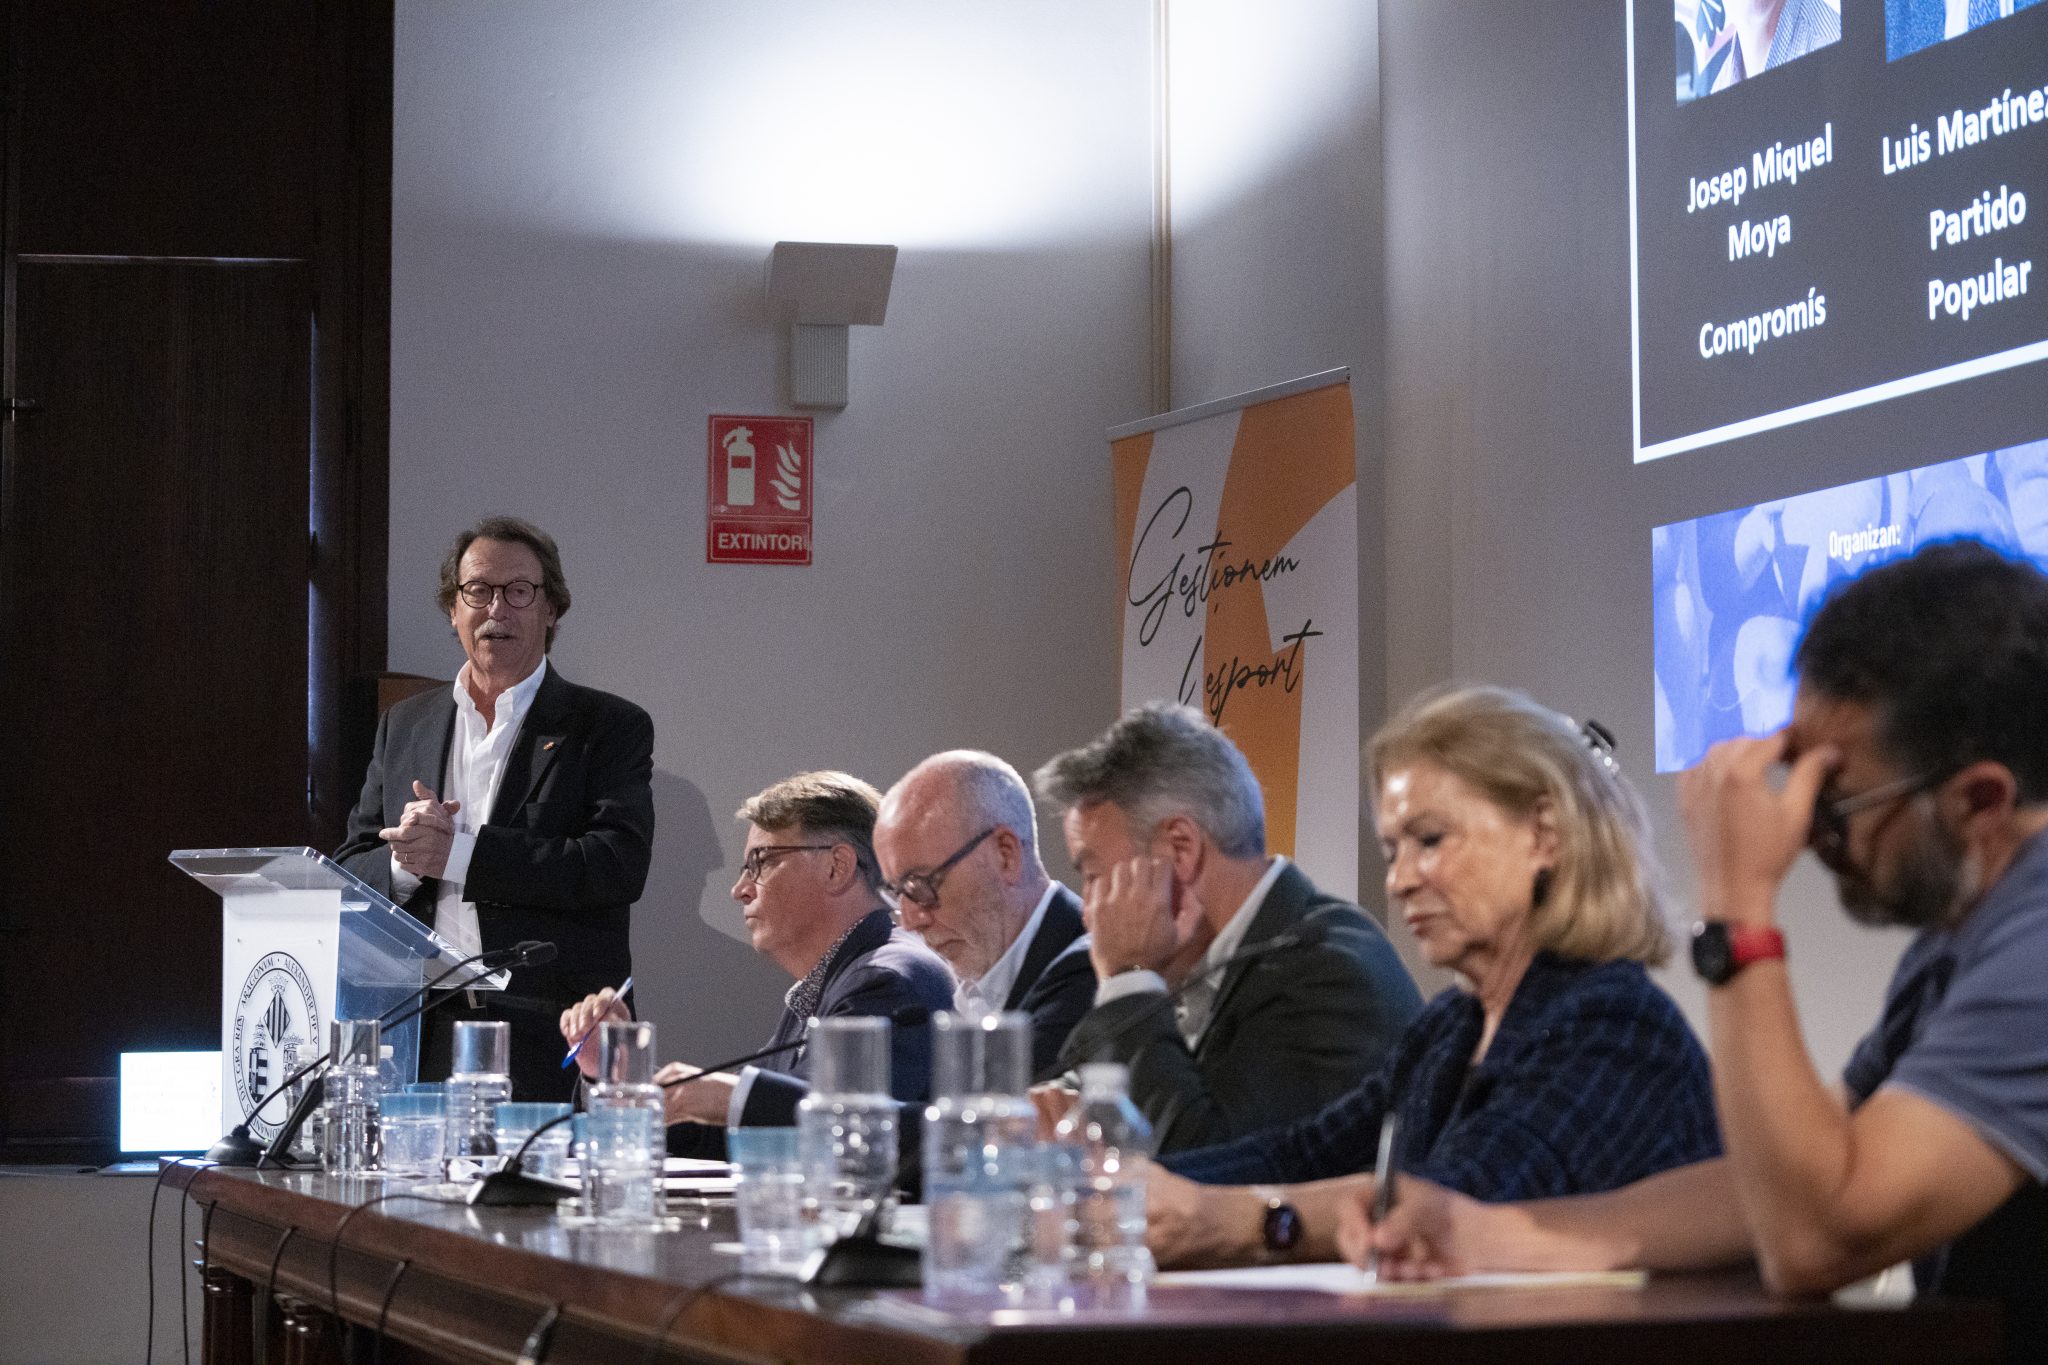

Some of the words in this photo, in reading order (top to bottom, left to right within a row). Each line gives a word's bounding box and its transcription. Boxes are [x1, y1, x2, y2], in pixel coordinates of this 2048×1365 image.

[1687, 164, 1747, 213] Josep
[1753, 122, 1833, 189] Miquel
[1883, 124, 1931, 175] Luis
[1728, 214, 1791, 261] Moya
[1930, 184, 2027, 250] Partido
[1928, 257, 2032, 321] Popular
[1699, 286, 1827, 359] Compromís
[718, 532, 803, 551] EXTINTOR
[1829, 523, 1901, 561] Organizan:
